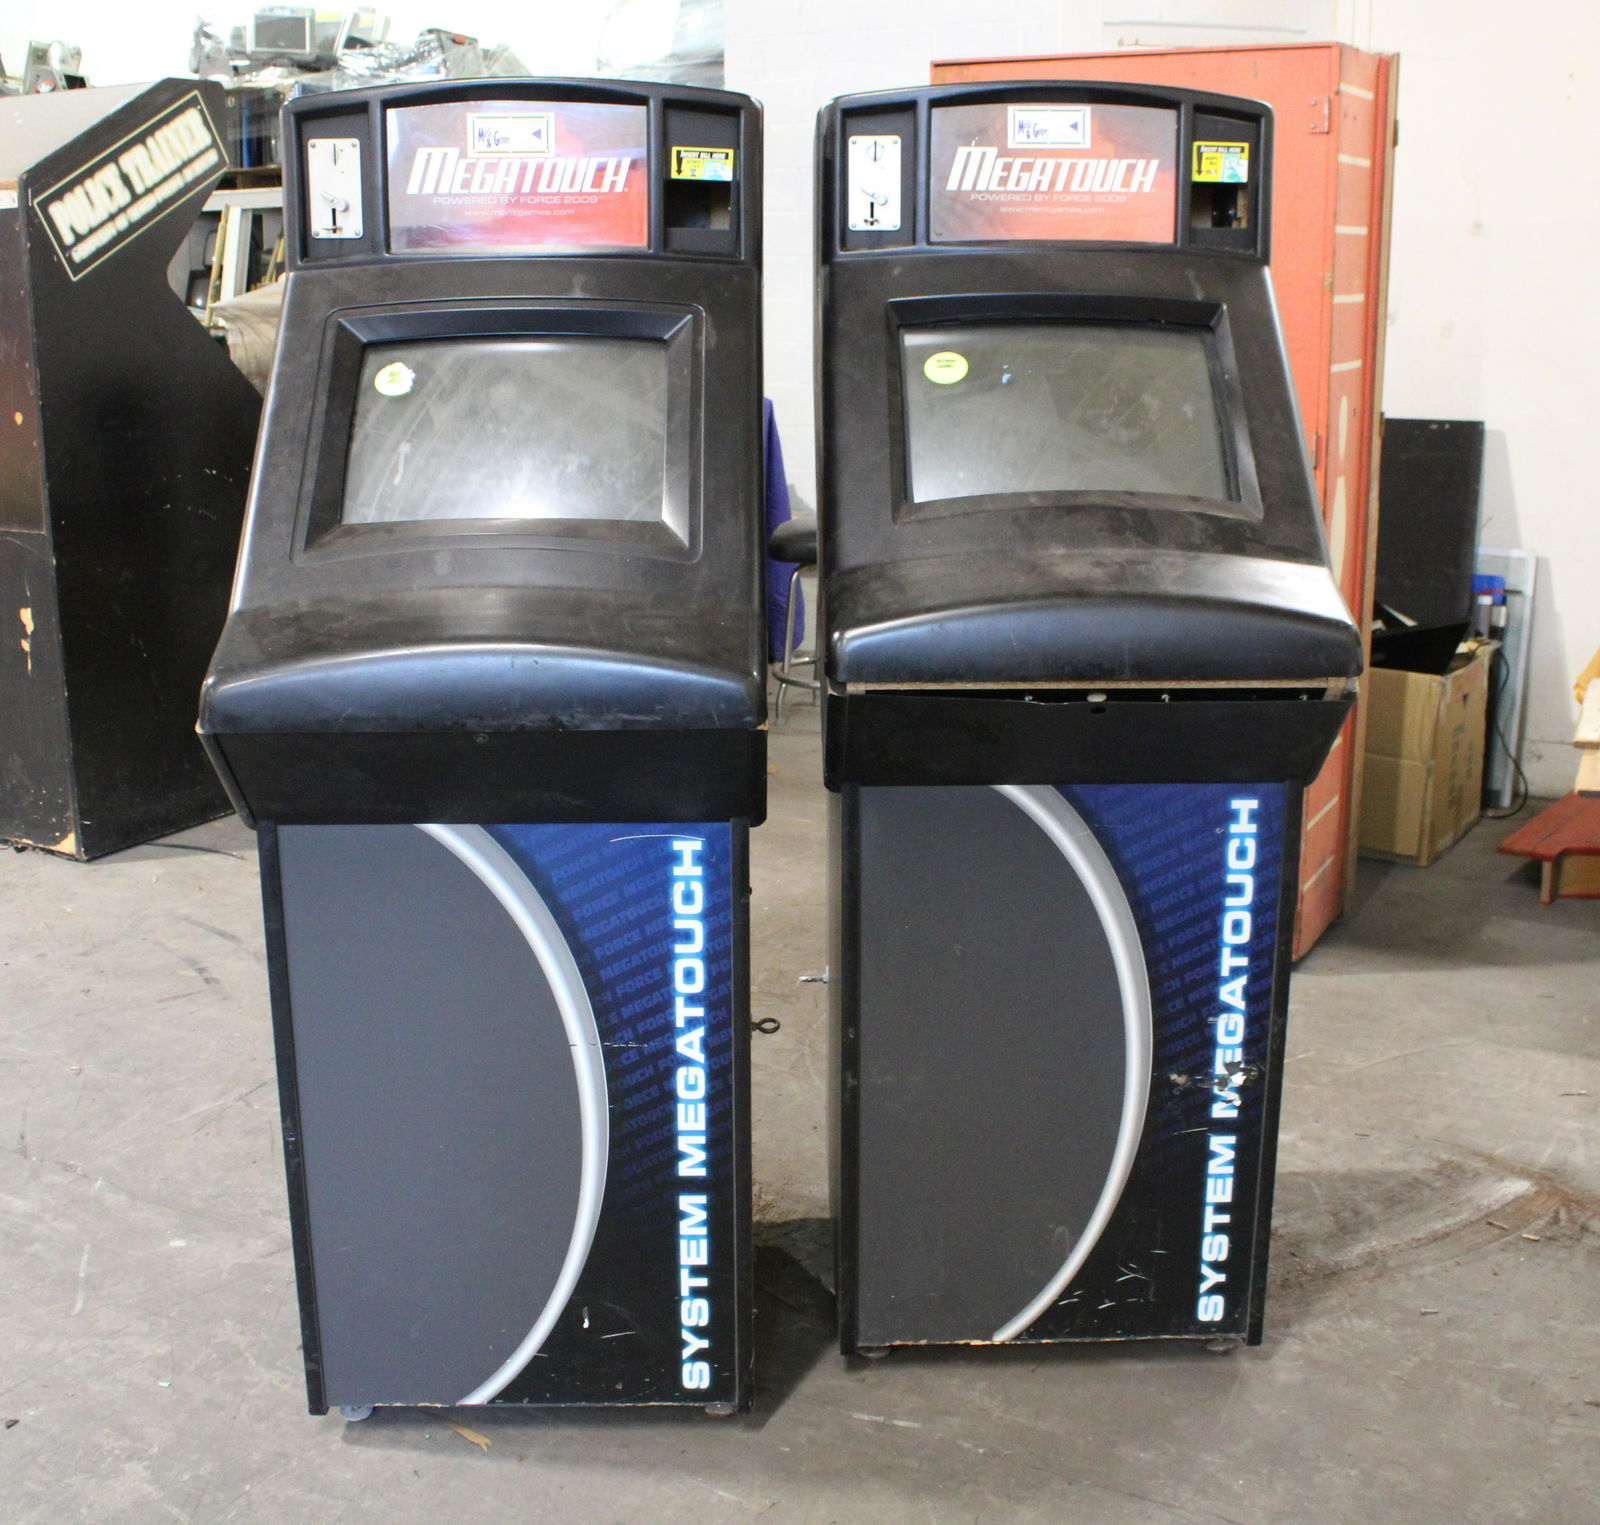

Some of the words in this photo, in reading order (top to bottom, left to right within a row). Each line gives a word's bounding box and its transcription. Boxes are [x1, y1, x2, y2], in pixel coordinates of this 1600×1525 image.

[48, 162, 132, 246] POLICE
[118, 107, 213, 195] TRAINER
[406, 147, 632, 195] MEGATOUCH
[433, 195, 498, 205] POWERED
[501, 195, 517, 205] BY
[520, 195, 561, 205] FORCE
[679, 150, 700, 158] INSERT
[711, 152, 727, 160] HERE
[946, 146, 1160, 193] MEGATOUCH
[971, 193, 1032, 202] POWERED
[1034, 194, 1052, 202] BY
[1053, 194, 1092, 202] FORCE
[1211, 799, 1259, 1118] MEGATOUCH
[672, 840, 708, 1177] MEGATOUCH
[1198, 1135, 1238, 1322] SYSTEM
[678, 1194, 710, 1390] SYSTEM
